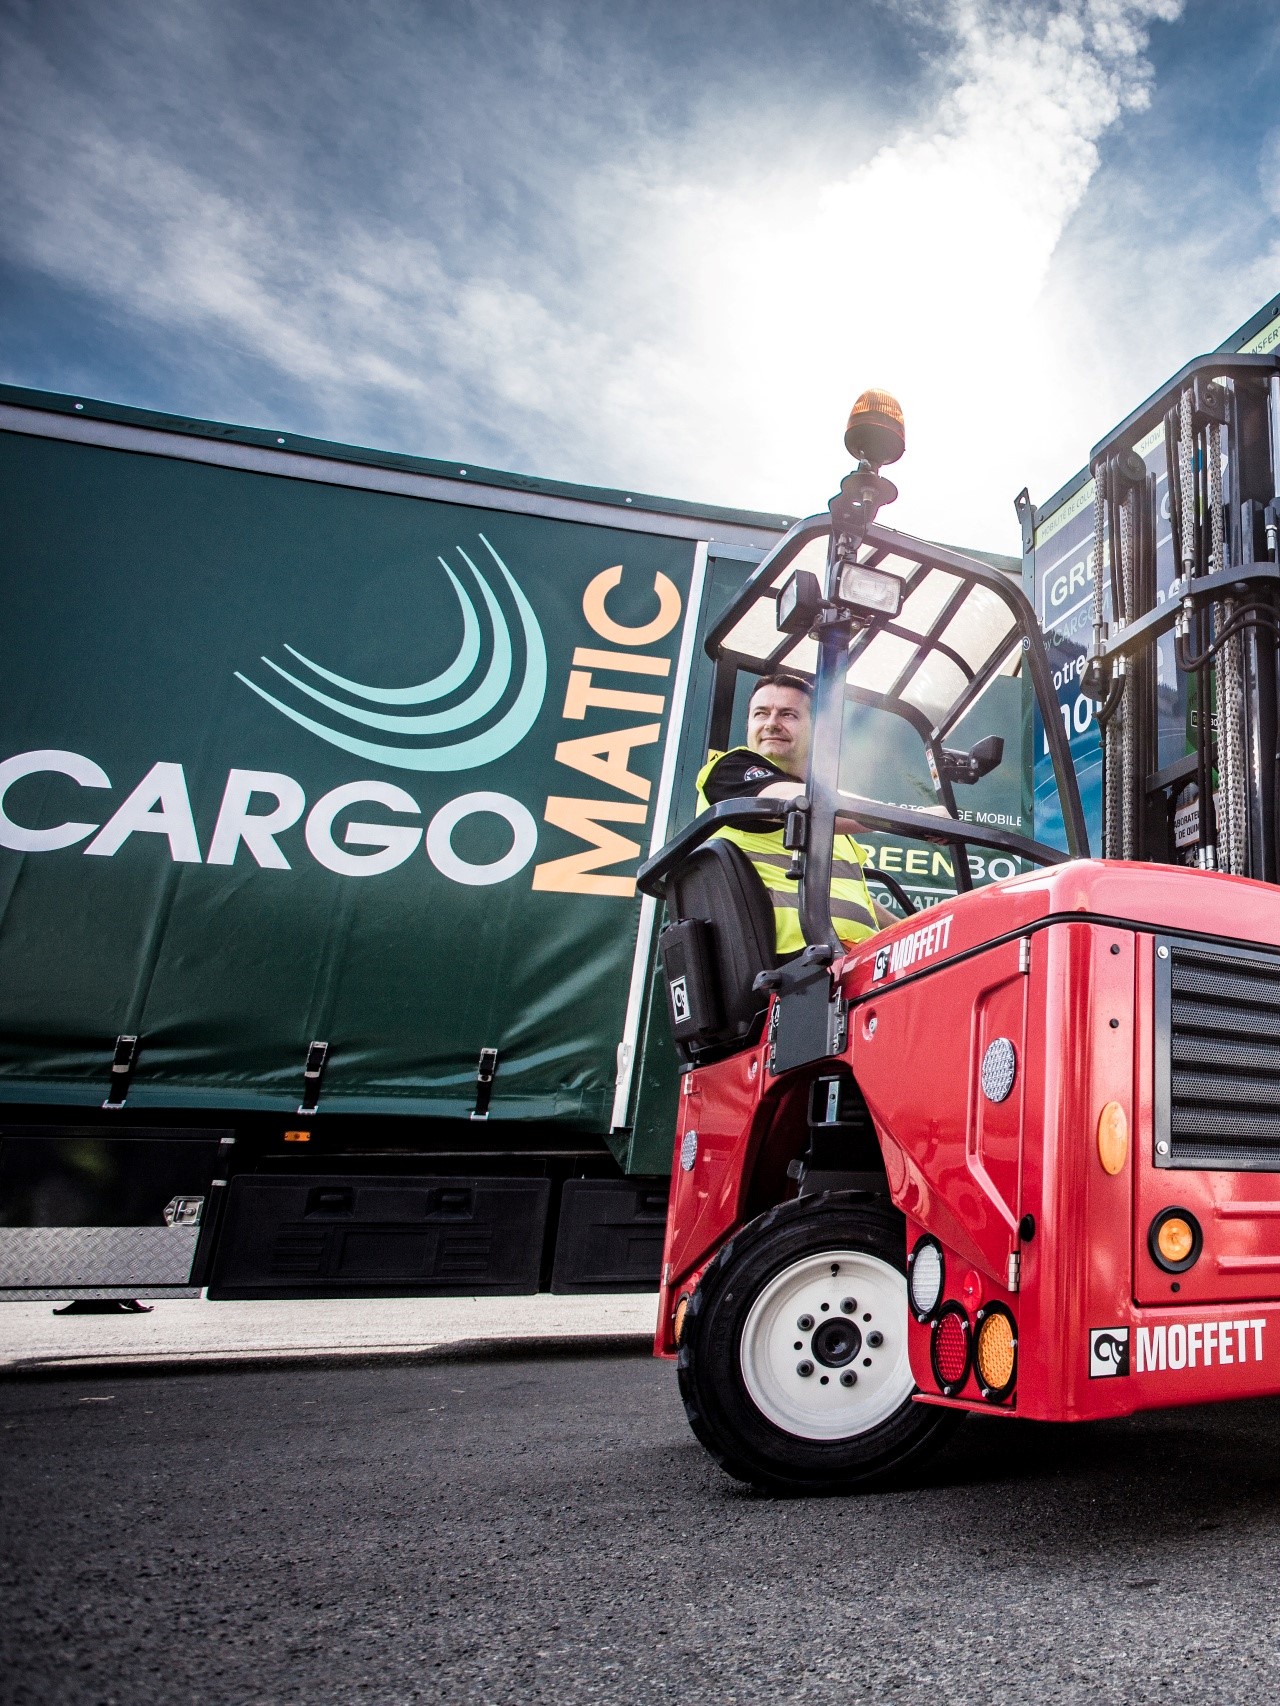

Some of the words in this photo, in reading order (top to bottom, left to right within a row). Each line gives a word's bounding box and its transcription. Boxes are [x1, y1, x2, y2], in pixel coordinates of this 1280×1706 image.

[1052, 654, 1086, 691] otre
[532, 564, 681, 897] MATIC
[0, 750, 537, 886] CARGO
[1179, 829, 1186, 840] DE
[890, 914, 954, 974] MOFFETT
[1136, 1318, 1266, 1373] MOFFETT
